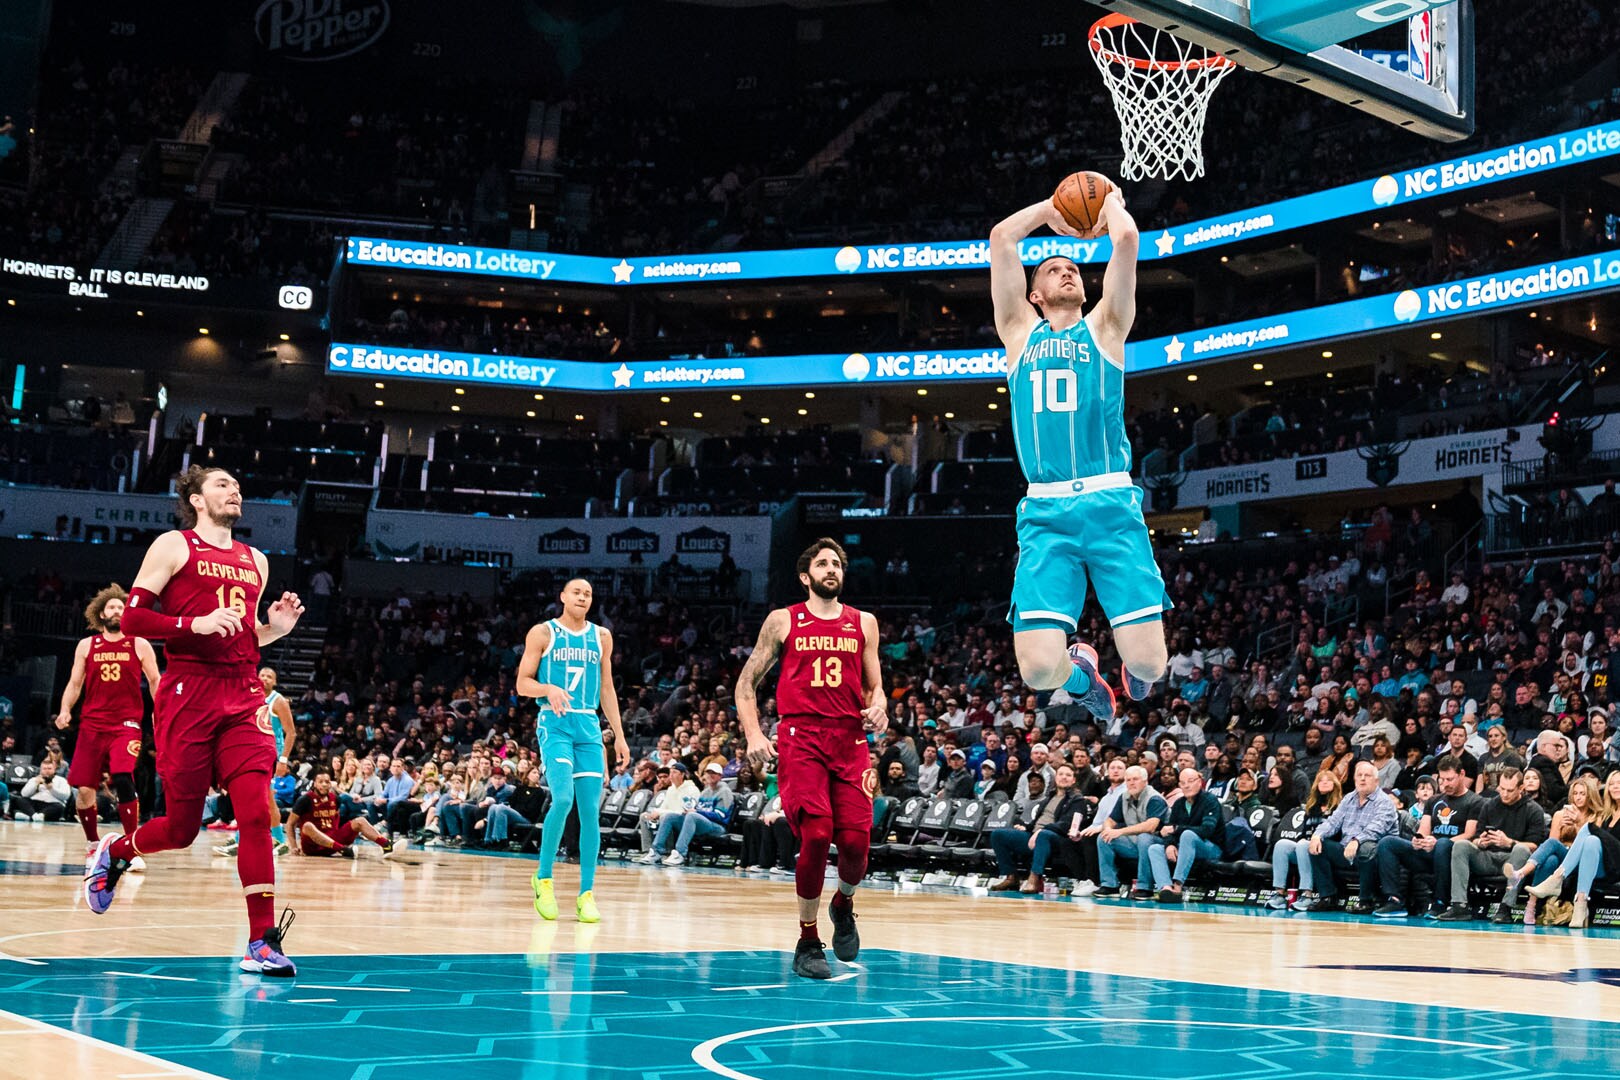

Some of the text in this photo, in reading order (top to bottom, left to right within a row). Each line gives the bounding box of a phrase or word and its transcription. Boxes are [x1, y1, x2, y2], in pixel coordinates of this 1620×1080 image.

[268, 1, 382, 53] Pepper
[1404, 129, 1620, 197] NC Education Lotte
[1183, 213, 1274, 246] nclottery.com
[358, 240, 471, 269] Education
[475, 250, 556, 279] Lottery
[867, 239, 1099, 269] NC Educati Lottery
[3, 258, 75, 280] HORNETS
[89, 268, 105, 282] IT
[106, 270, 122, 284] IS
[124, 271, 209, 291] CLEVELAND
[643, 260, 741, 278] nclottery.com
[68, 282, 108, 298] BALL.
[283, 290, 308, 306] CC
[1428, 285, 1462, 313] NC
[1466, 265, 1589, 307] Education
[1193, 322, 1288, 354] nclottery.com
[876, 351, 1007, 377] NC Educatio
[1022, 338, 1091, 367] HORNETS
[330, 347, 556, 386] C Education Lottery
[643, 365, 744, 384] nclottery.com
[1029, 368, 1078, 413] 10
[1302, 461, 1321, 476] 113
[1436, 442, 1512, 471] HORNETS
[1207, 473, 1270, 499] HORNETS
[95, 508, 179, 524] CHARLO
[197, 560, 258, 586] CLEVELAND
[215, 584, 247, 619] 16
[93, 652, 130, 662] CLEVELAND
[553, 647, 599, 664] HORNETS
[795, 636, 858, 653] CLEVELAND
[100, 663, 121, 682] 33
[567, 666, 585, 691] 7
[810, 656, 842, 687] 13
